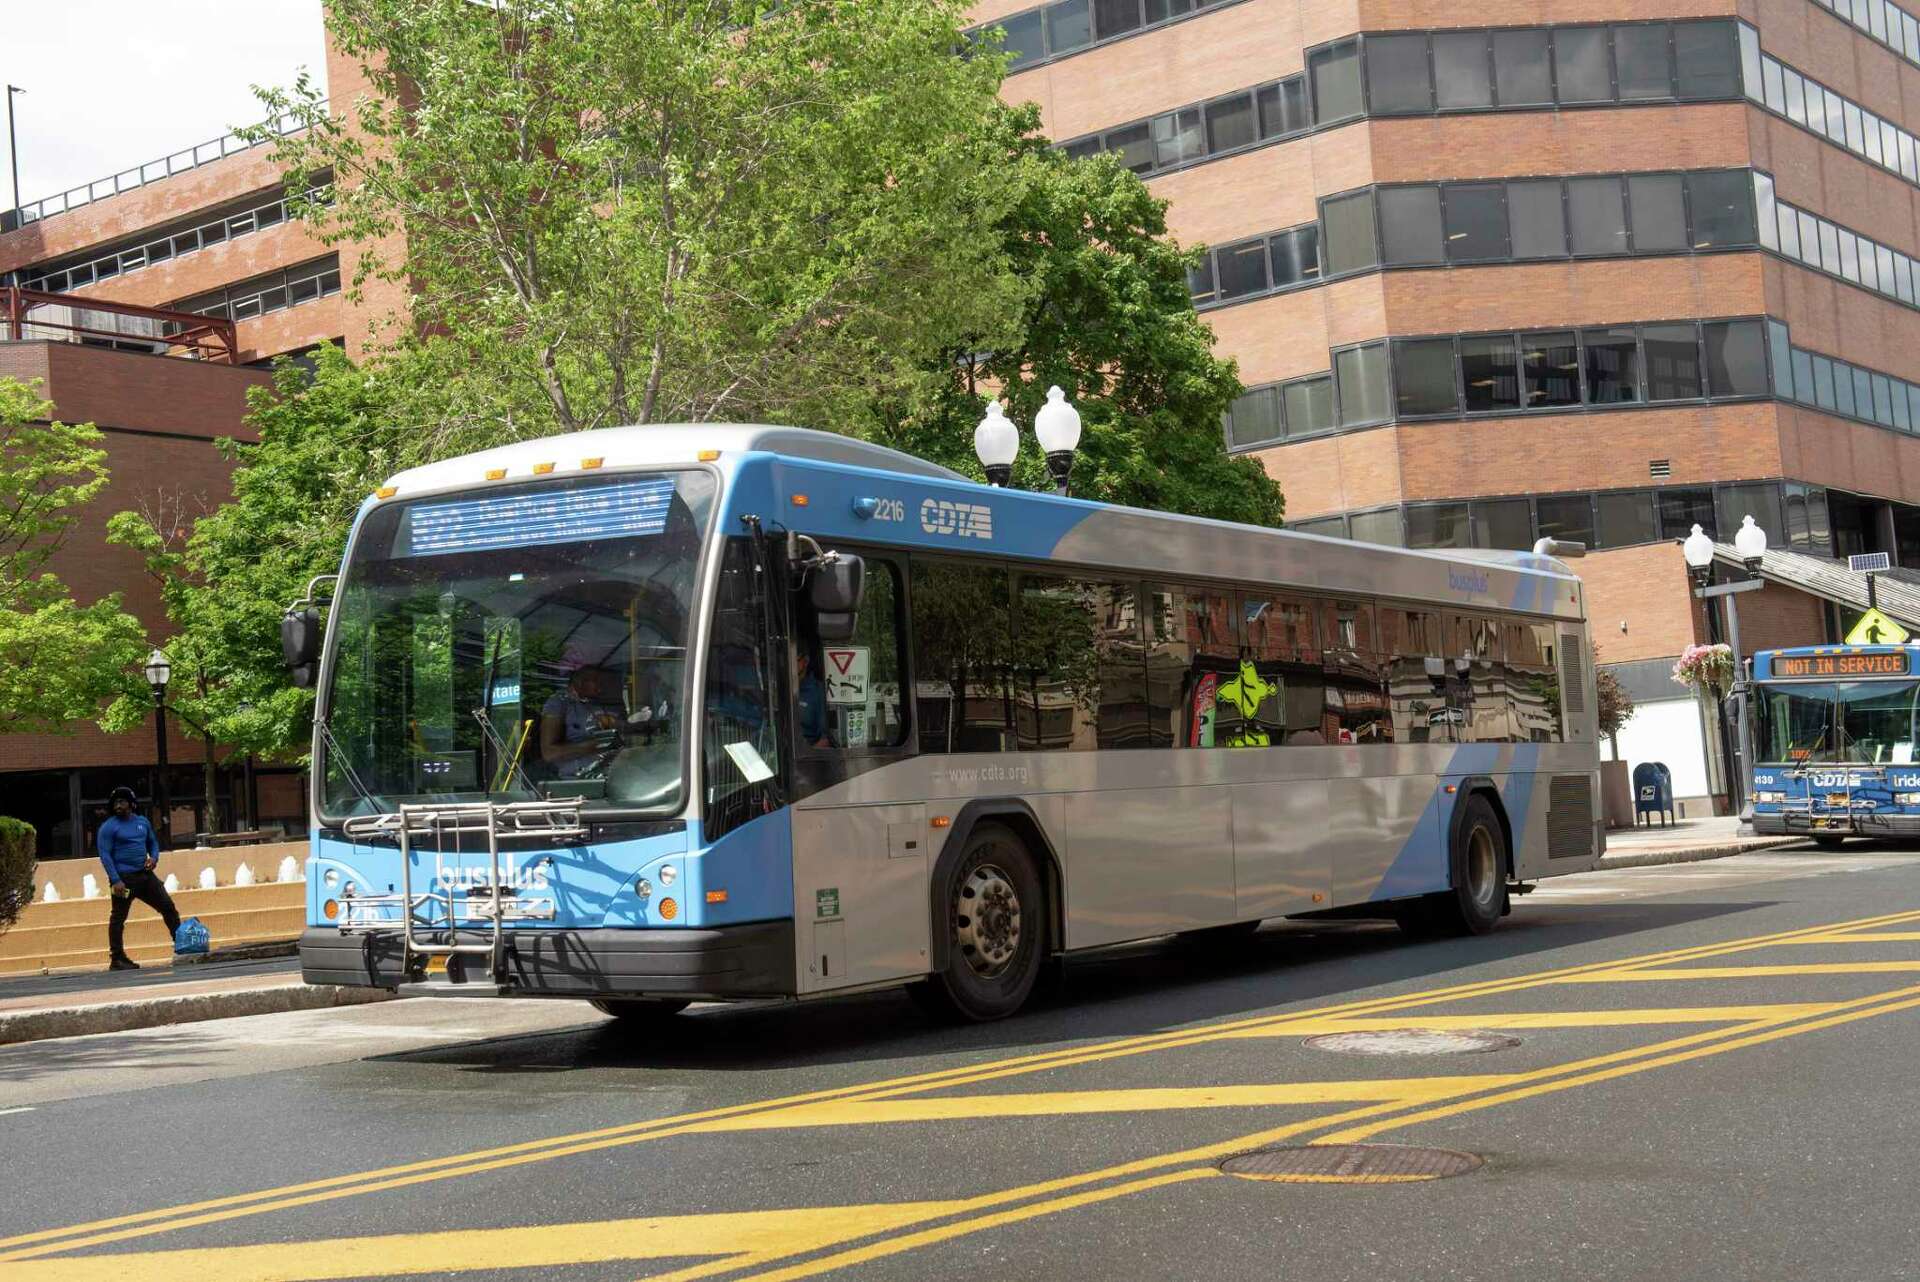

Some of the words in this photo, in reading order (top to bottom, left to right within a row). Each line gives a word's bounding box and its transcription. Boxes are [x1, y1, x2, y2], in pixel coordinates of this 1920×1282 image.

[873, 498, 904, 522] 2216
[920, 498, 993, 539] CDTA
[1785, 659, 1809, 675] NOT
[1816, 658, 1834, 674] IN
[1840, 656, 1901, 673] SERVICE
[492, 684, 520, 699] tate
[1813, 774, 1861, 787] CDTA
